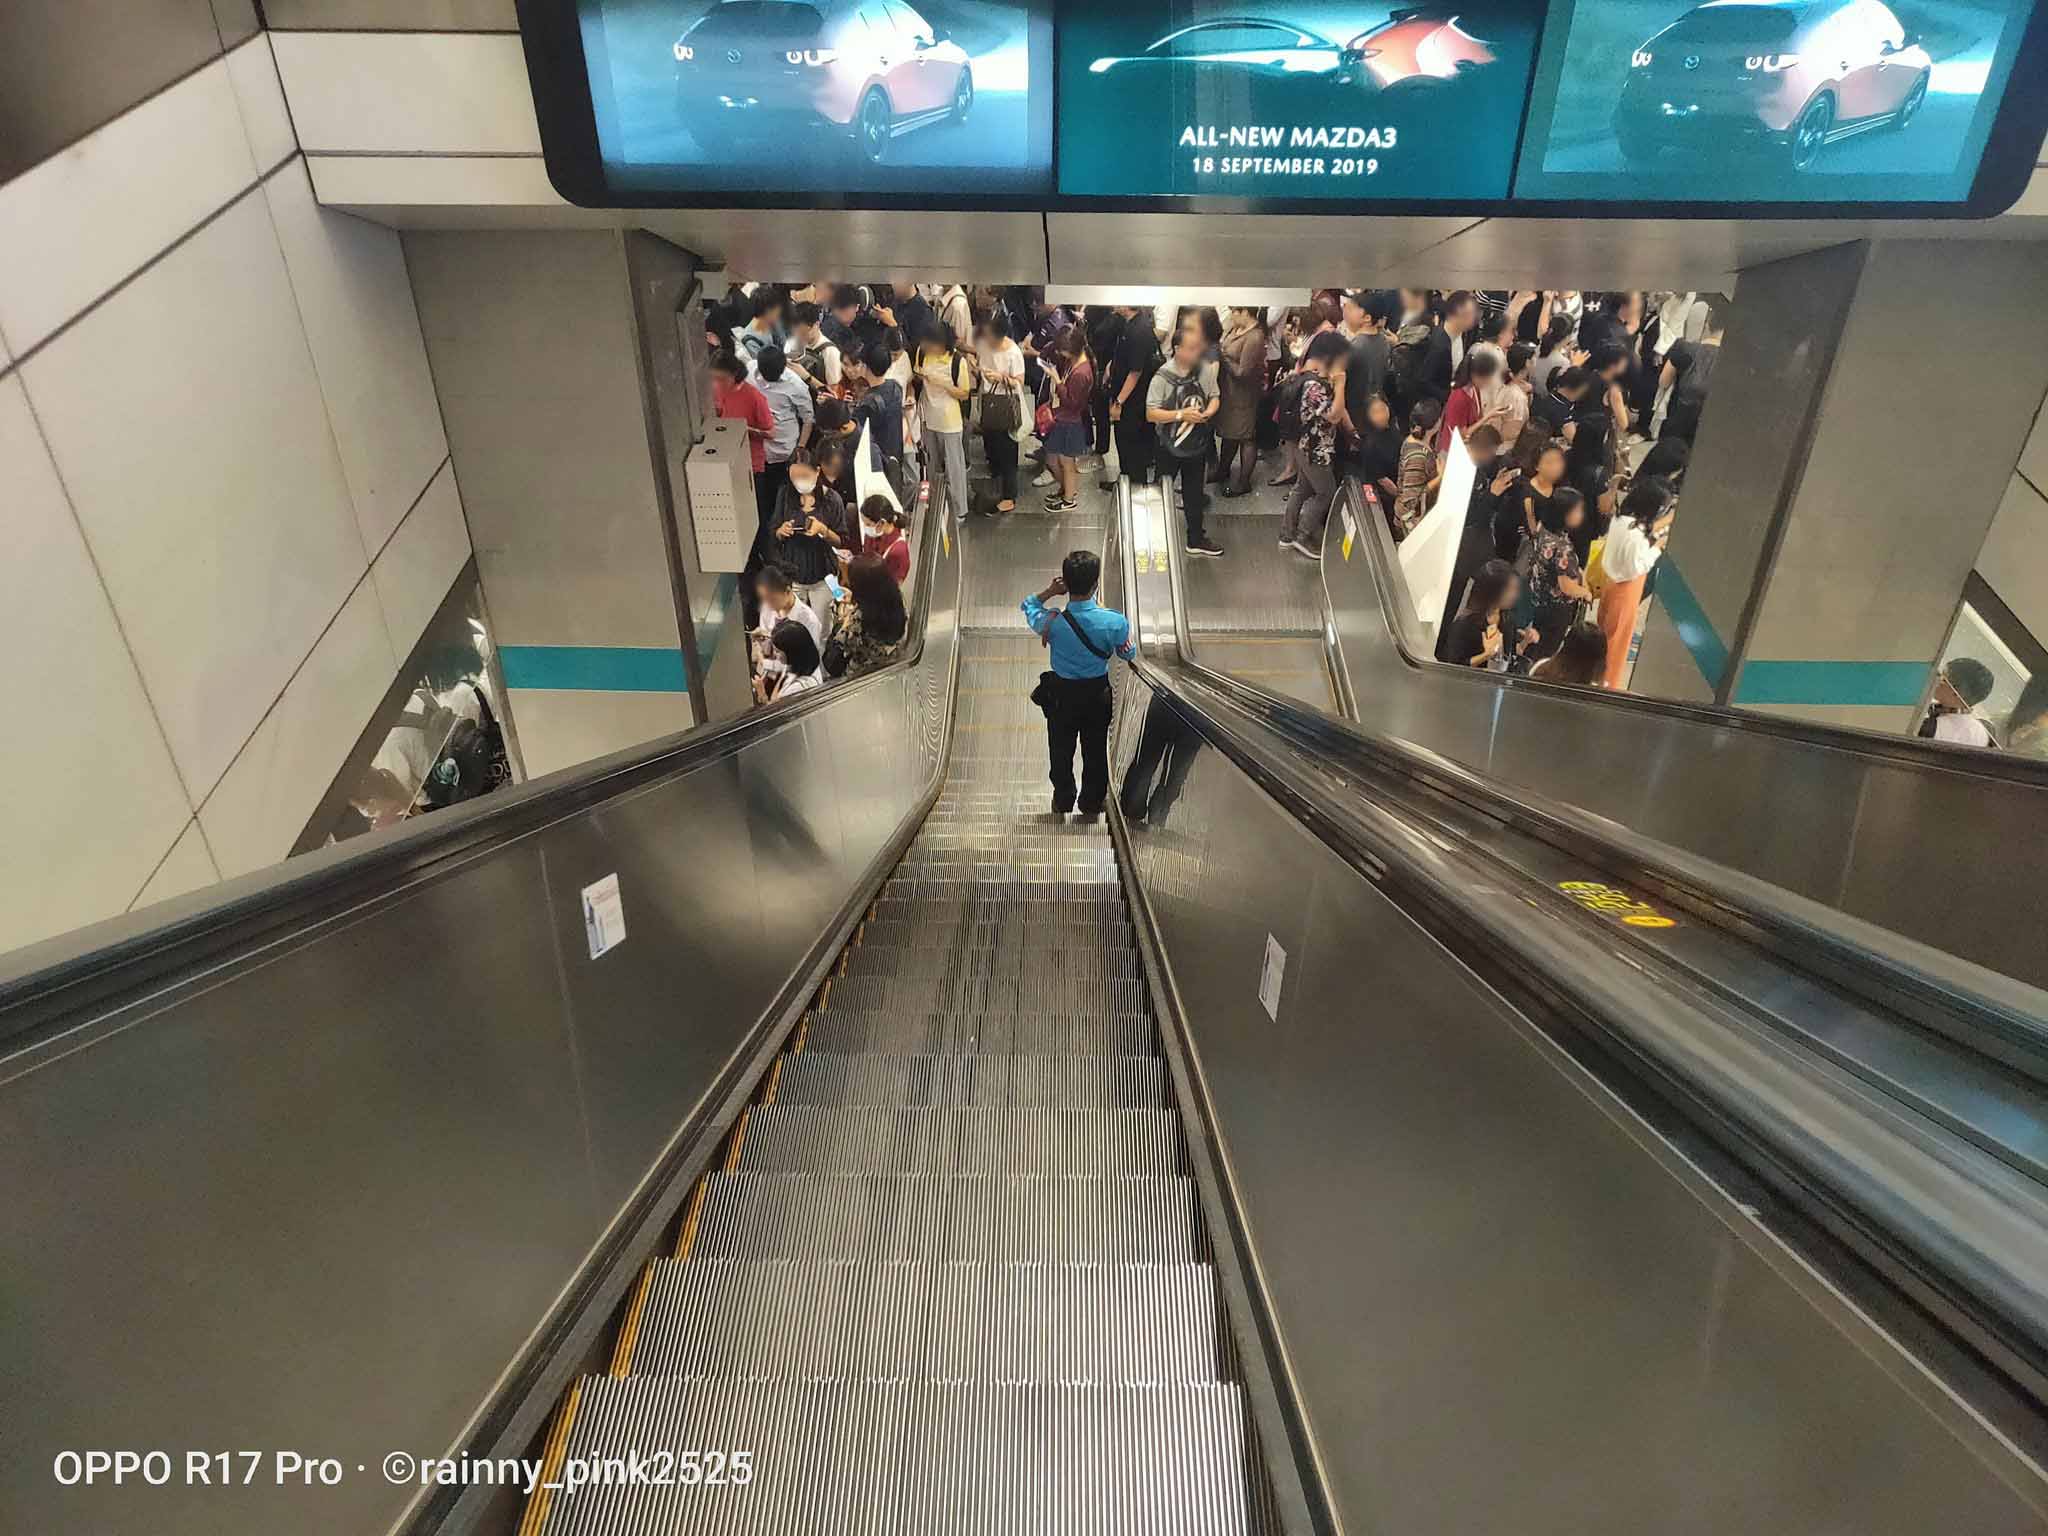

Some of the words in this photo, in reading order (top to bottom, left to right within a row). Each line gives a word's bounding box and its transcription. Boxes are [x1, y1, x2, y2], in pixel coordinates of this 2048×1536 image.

[1179, 126, 1285, 148] ALL-NEW
[1290, 127, 1397, 149] MAZDA3
[1193, 157, 1214, 174] 18
[1221, 157, 1325, 174] SEPTEMBER
[1331, 158, 1378, 175] 2019
